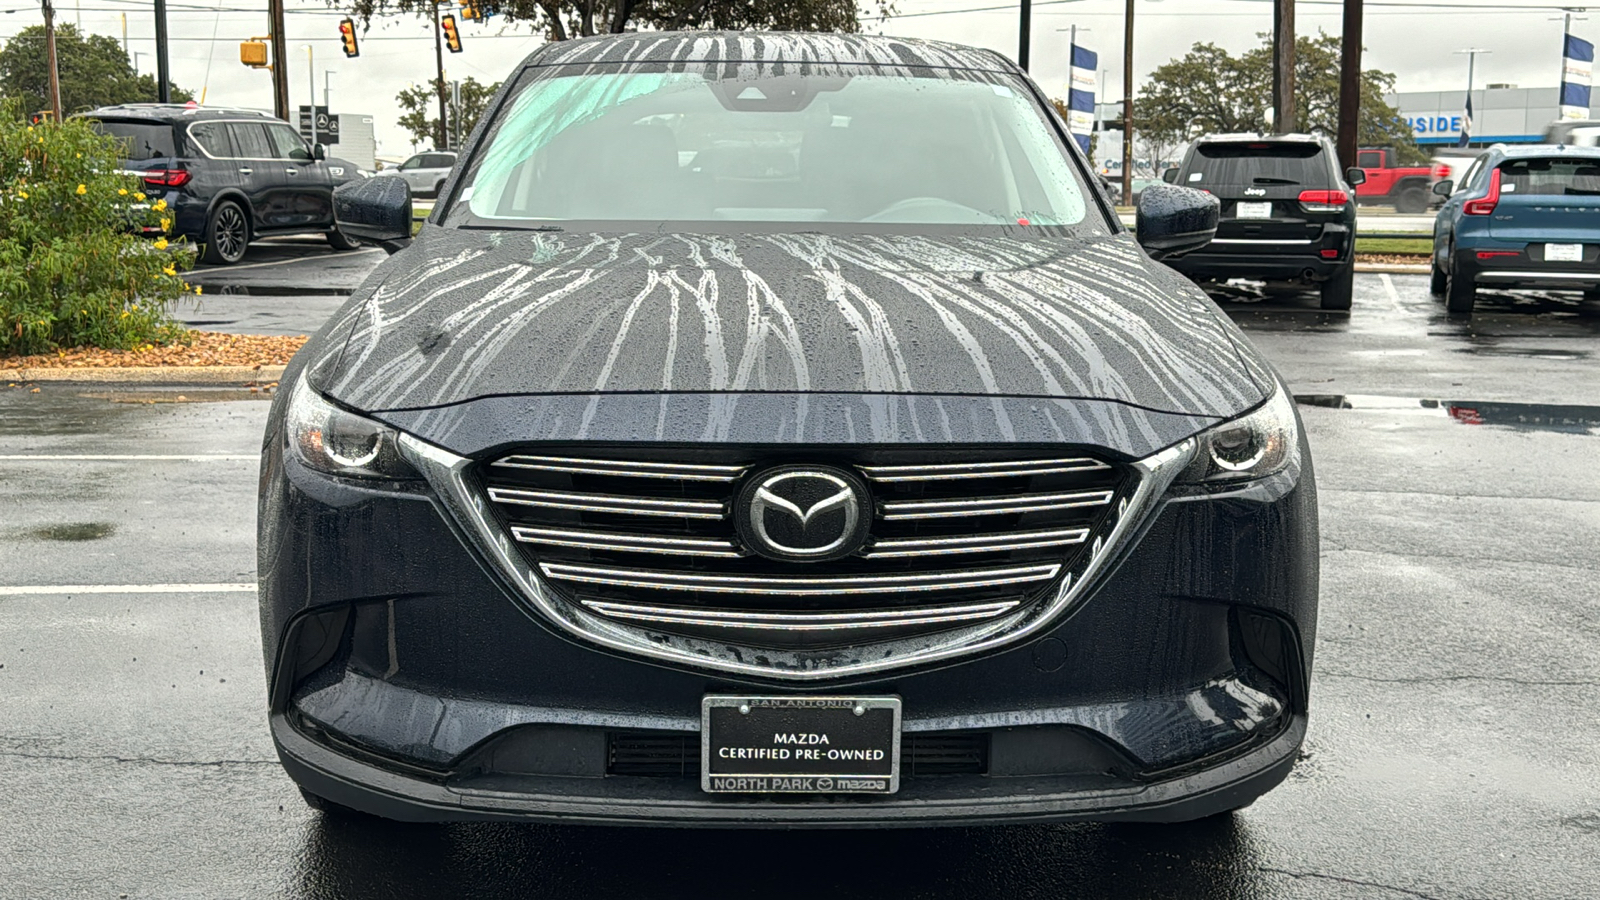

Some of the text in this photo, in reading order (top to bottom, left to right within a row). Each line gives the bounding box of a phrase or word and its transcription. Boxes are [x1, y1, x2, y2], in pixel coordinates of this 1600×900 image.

[1244, 187, 1266, 197] Jeep
[750, 699, 853, 707] SAN ANTONIO
[773, 733, 830, 745] MAZDA
[718, 747, 884, 761] CERTIFIED PRE-OWNED
[714, 778, 768, 790] NORTH
[772, 778, 813, 790] PARK
